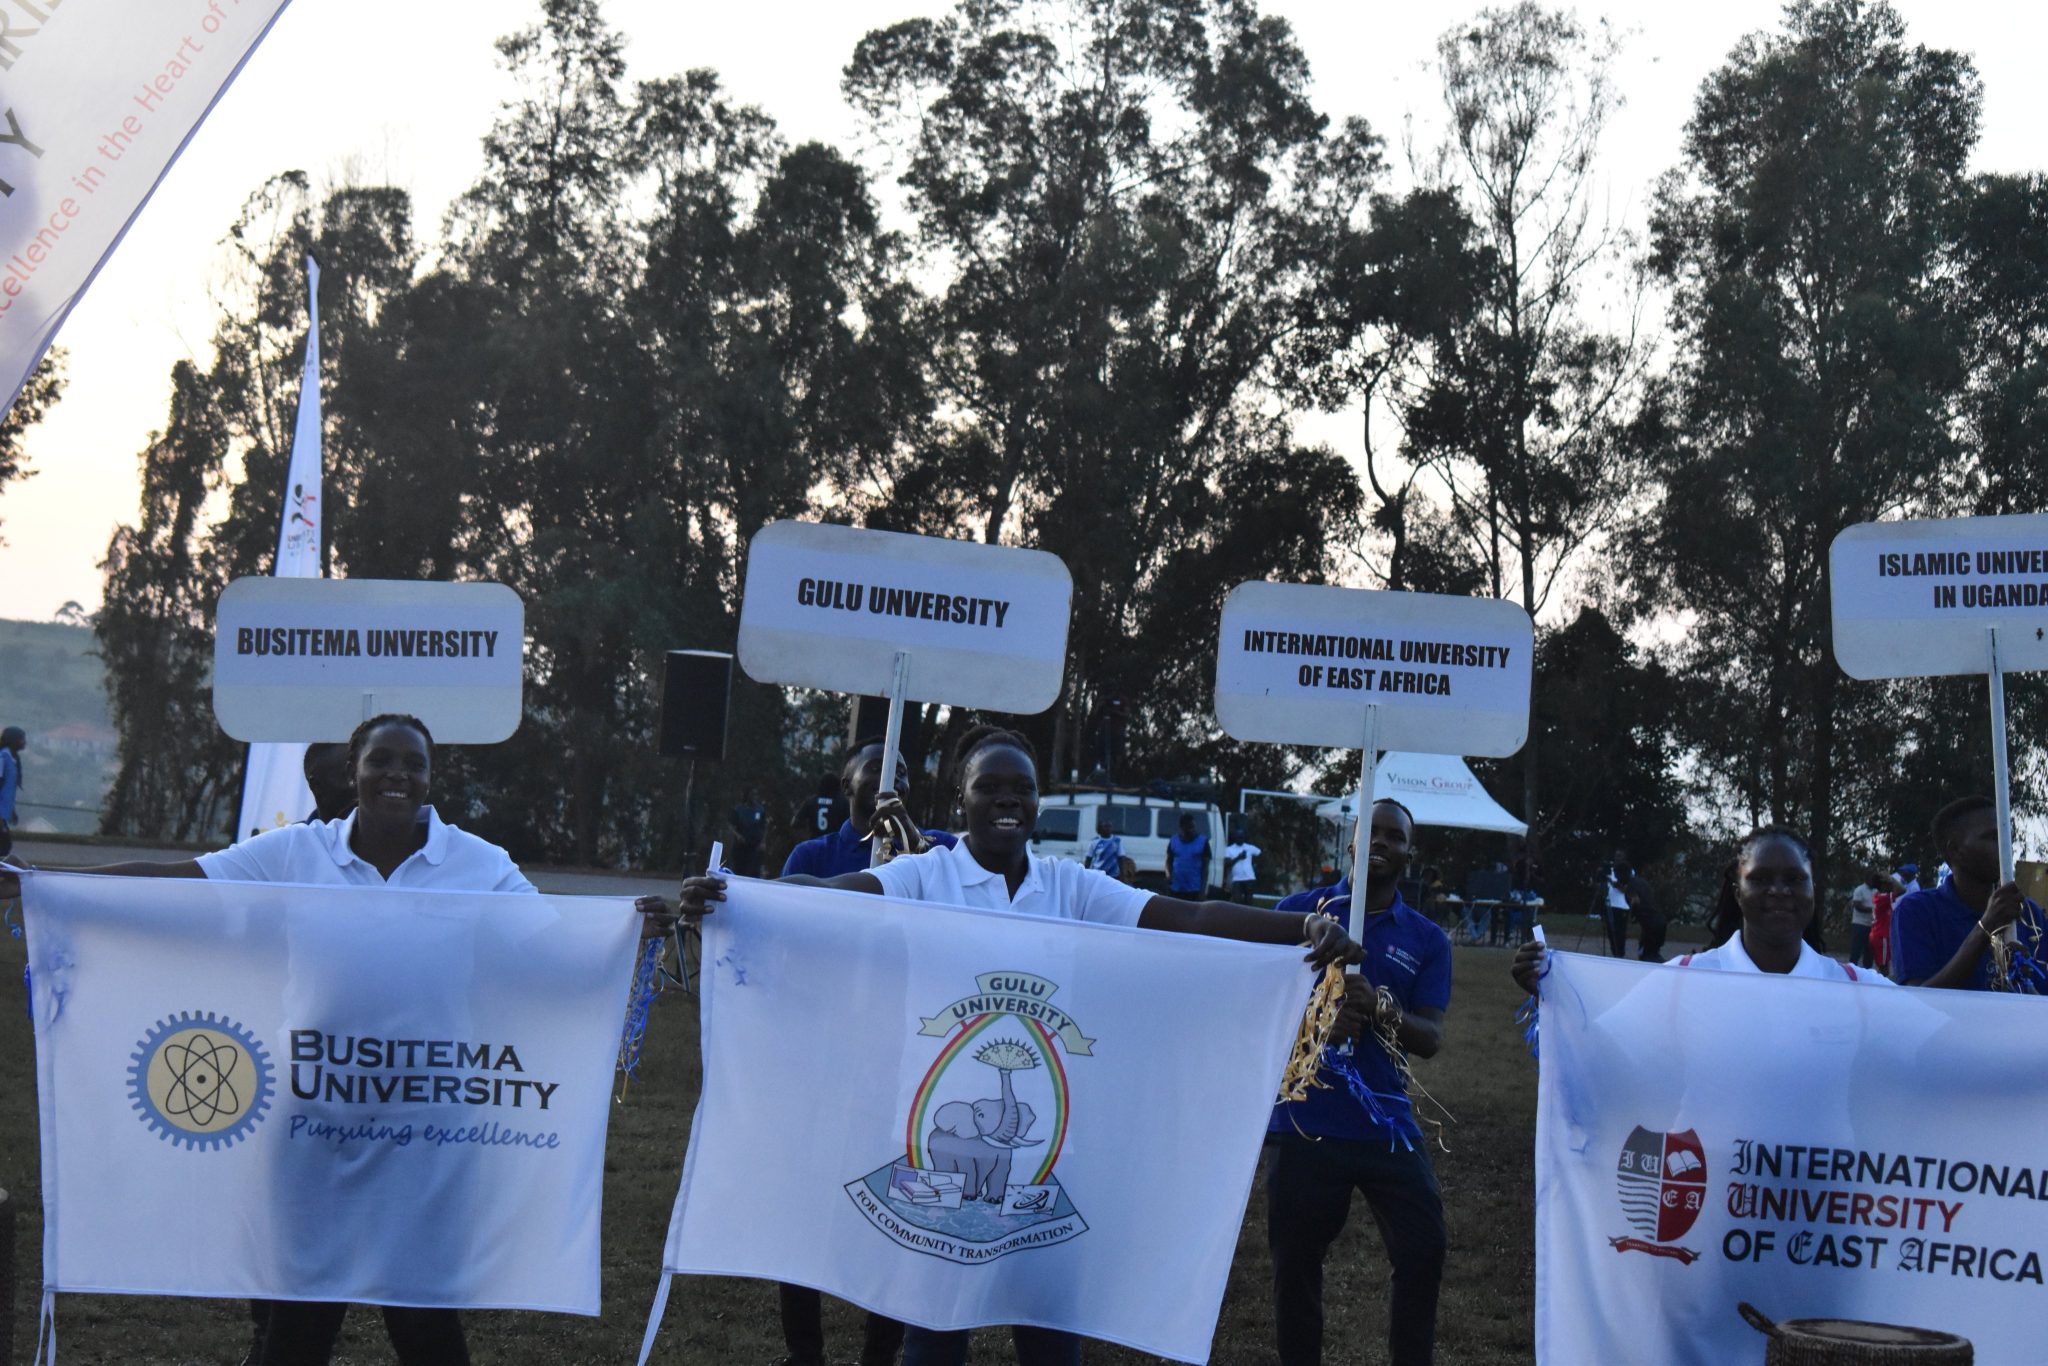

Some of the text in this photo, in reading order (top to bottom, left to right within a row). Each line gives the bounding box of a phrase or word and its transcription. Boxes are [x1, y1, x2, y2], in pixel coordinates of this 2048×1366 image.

[0, 0, 227, 318] cellence in the Heart of
[1879, 550, 2048, 577] ISLAMIC UNIVE
[797, 577, 1009, 628] GULU UNVERSITY
[1934, 583, 2048, 608] IN UGANDA
[237, 628, 498, 657] BUSITEMA UNVERSITY
[1244, 630, 1510, 668] INTERNATIONAL UNVERSITY
[1299, 664, 1451, 696] OF EAST AFRICA
[818, 808, 828, 830] 6
[989, 976, 1045, 997] GULU
[952, 997, 1071, 1032] UNIVERSITY
[290, 1029, 524, 1073] BUSITEMA
[290, 1065, 560, 1110] UNIVERSITY
[290, 1114, 561, 1150] Pursuing excellence
[1729, 1138, 2048, 1201] INTERNATIONAL
[856, 1190, 1074, 1260] FOR COMMUNITY TRANSFORMATION
[1728, 1182, 1964, 1233] UNIVERSITY
[1722, 1229, 2044, 1285] OF EAST AFRICA
